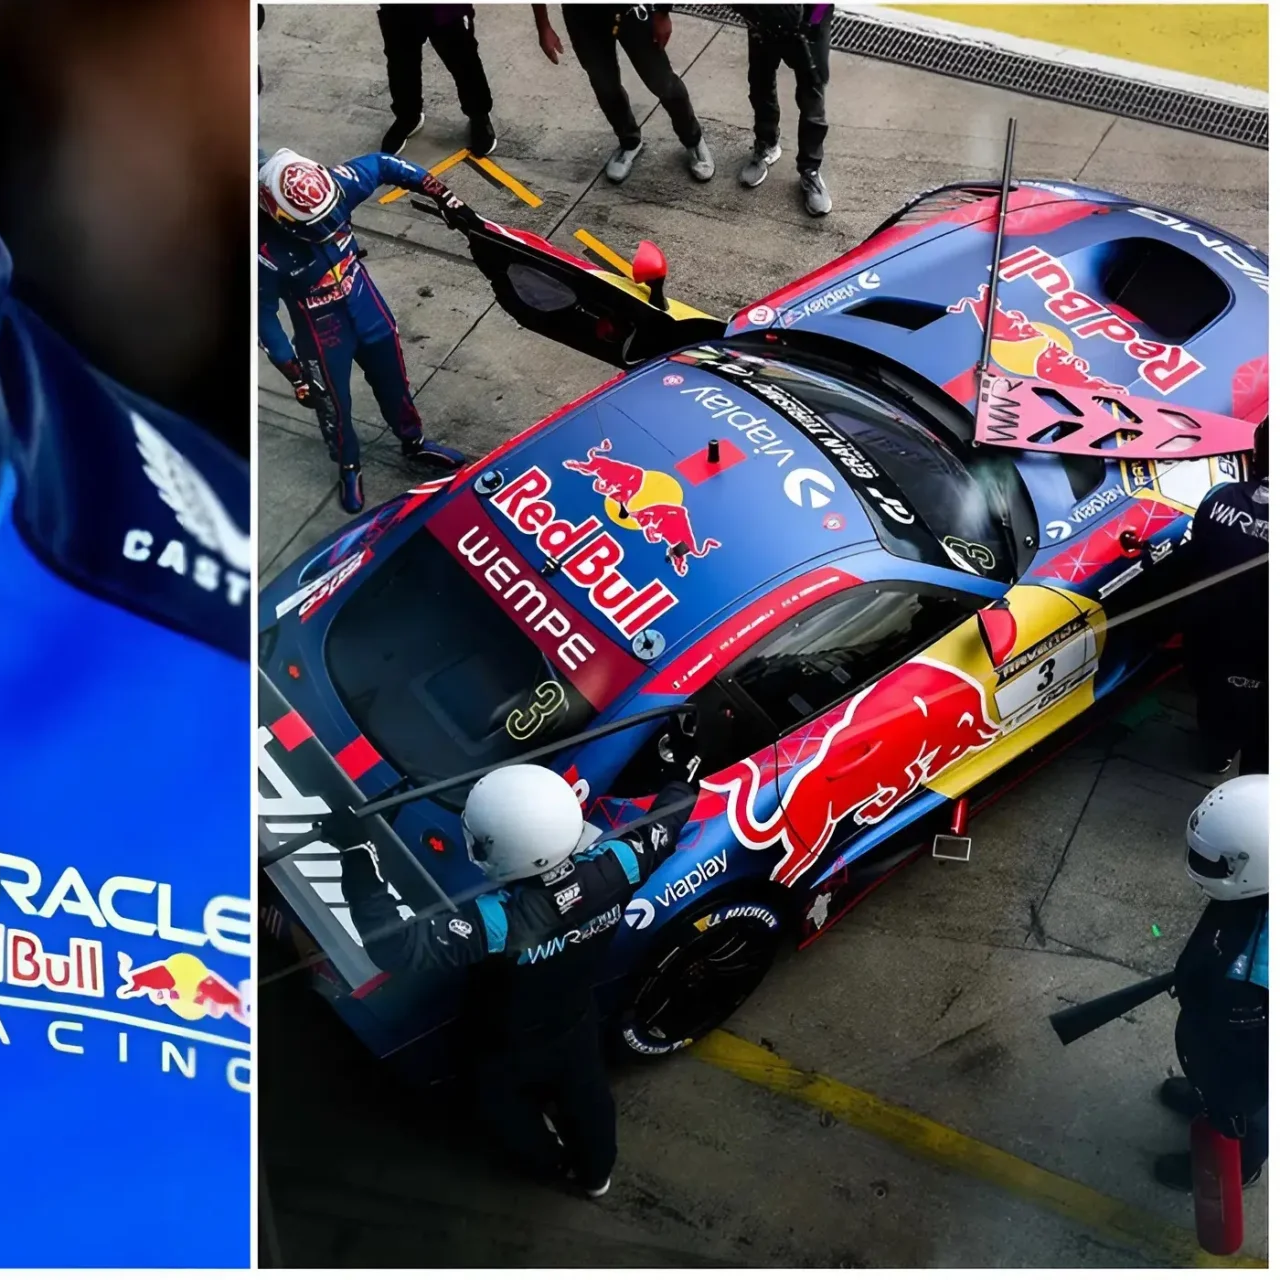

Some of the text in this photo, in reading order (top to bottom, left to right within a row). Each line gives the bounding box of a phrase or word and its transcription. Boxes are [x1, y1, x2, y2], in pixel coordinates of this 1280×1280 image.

[997, 245, 1207, 396] Bull Red
[680, 384, 795, 468] viaplay
[489, 465, 603, 560] Red
[561, 531, 680, 641] Bull
[457, 525, 596, 671] WEMPE
[505, 680, 565, 740] 3
[1036, 658, 1056, 692] 3
[655, 849, 728, 907] viaplay
[5, 928, 104, 998] Bull
